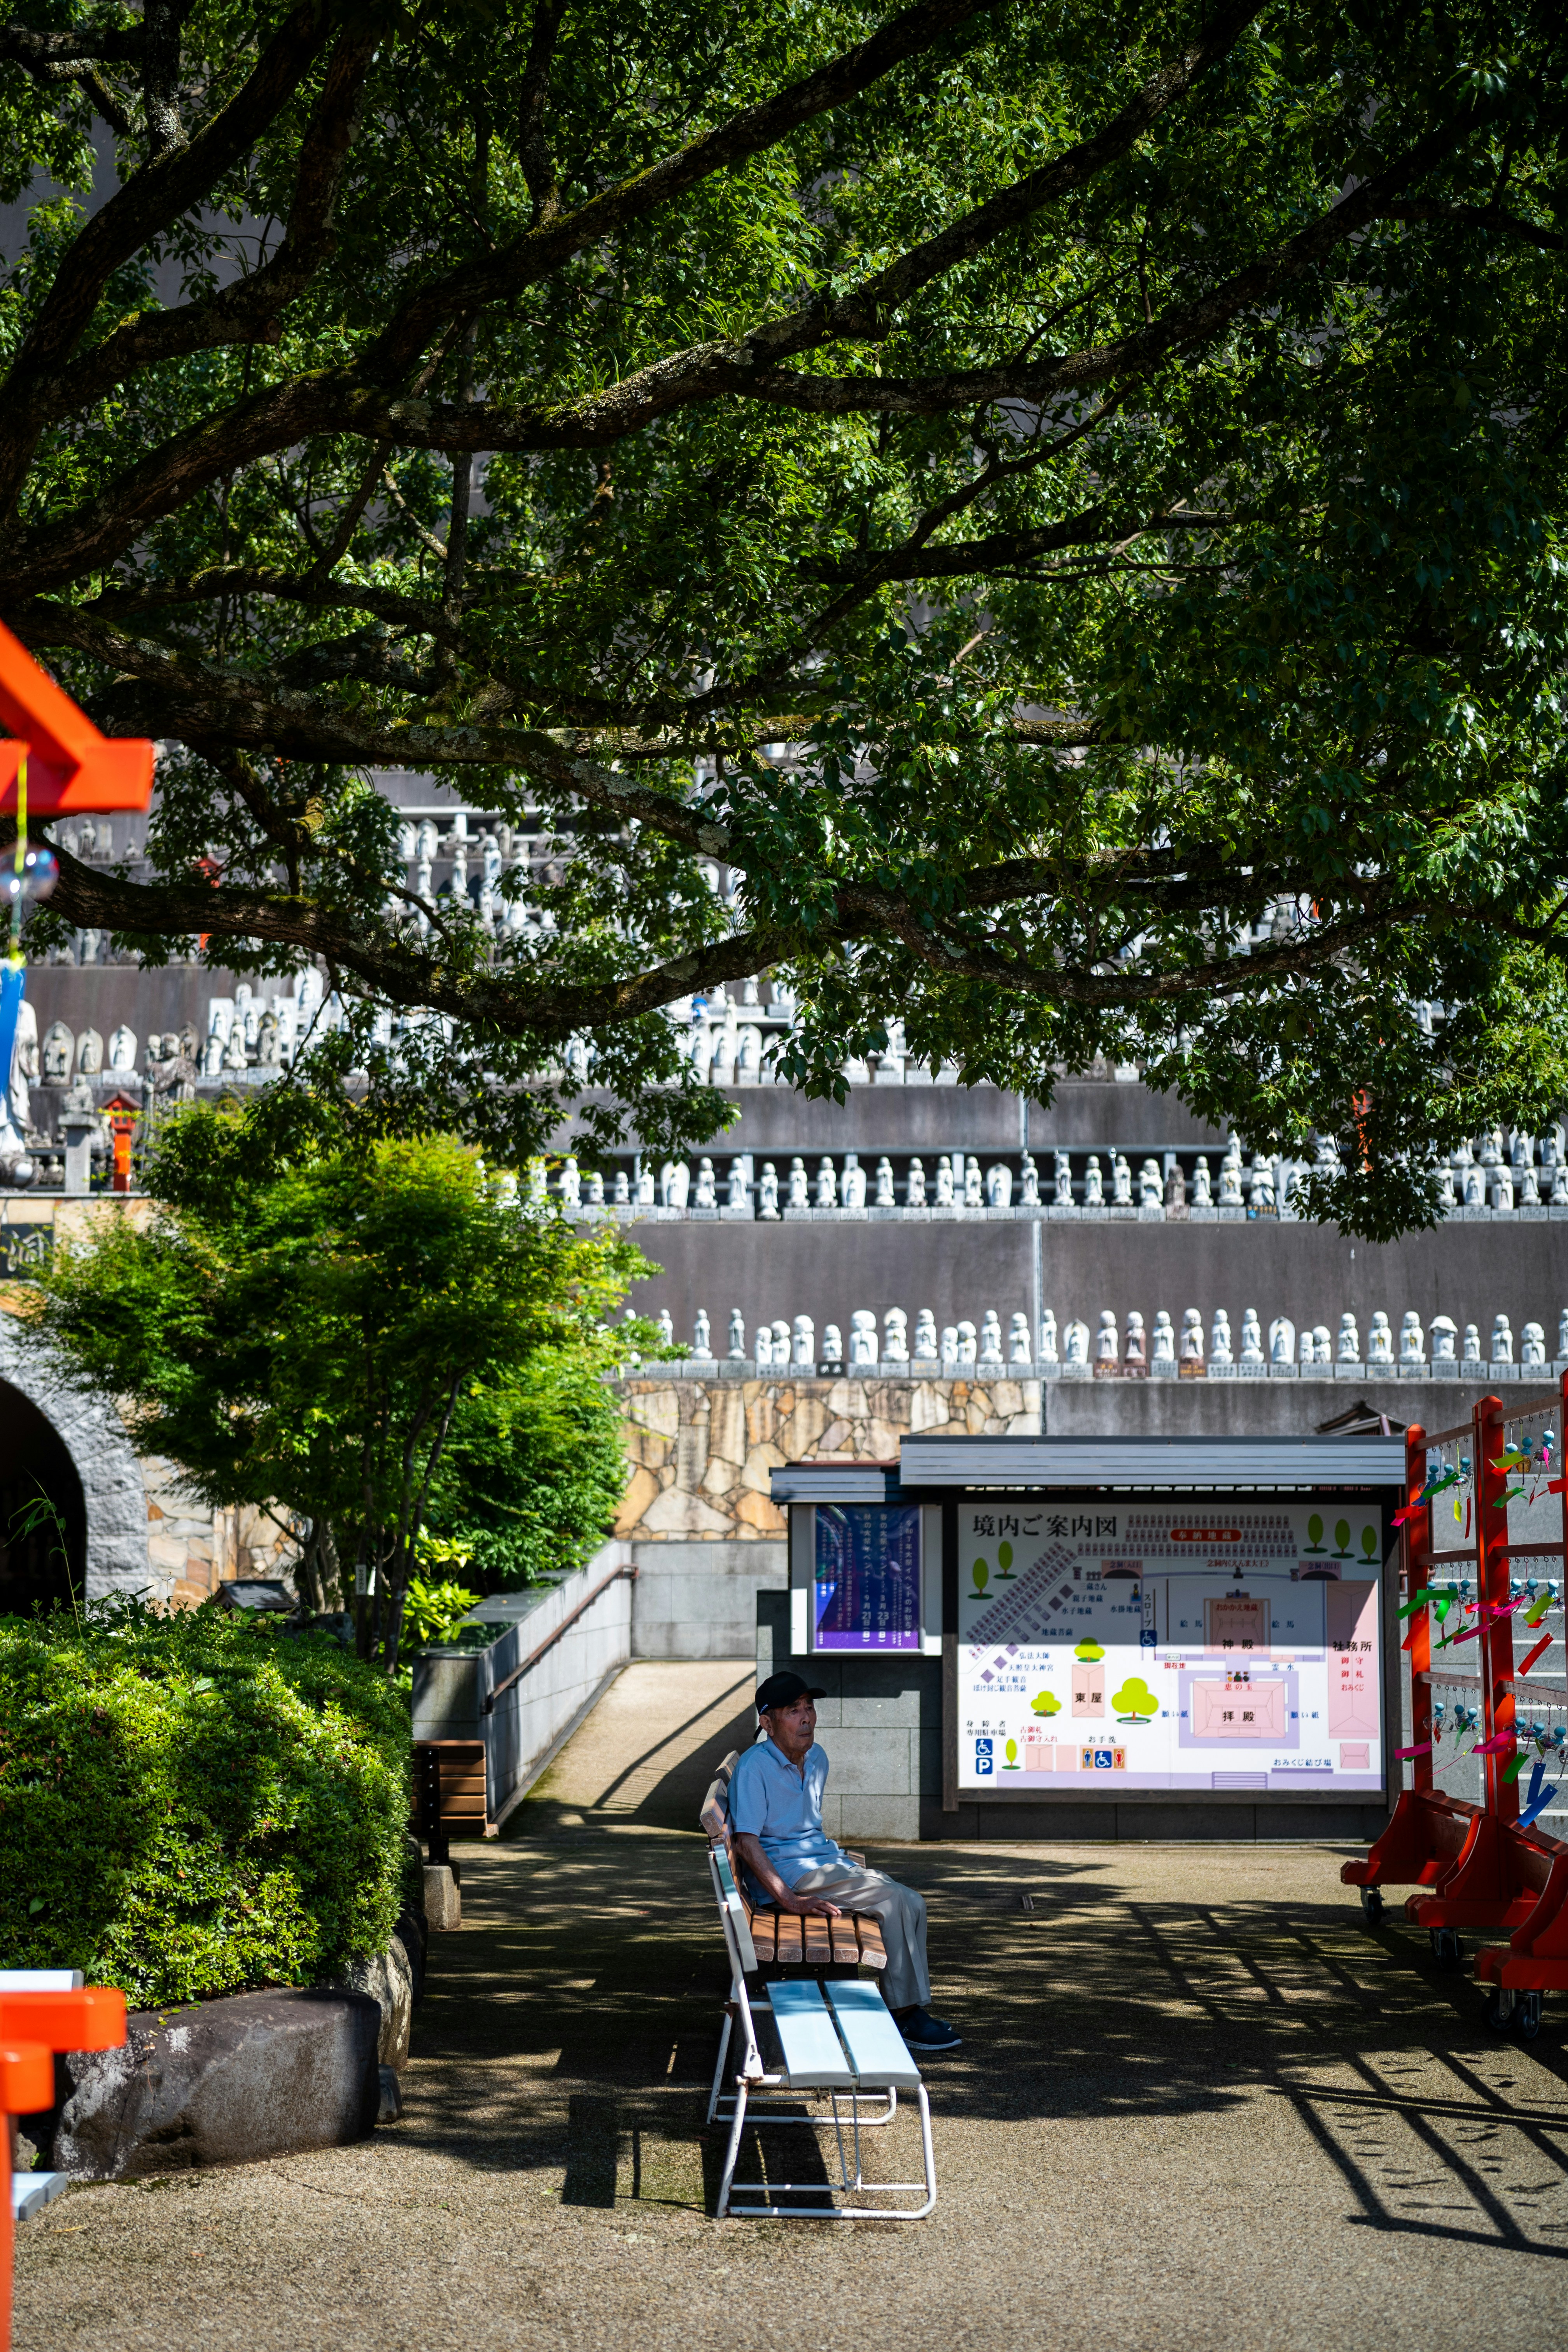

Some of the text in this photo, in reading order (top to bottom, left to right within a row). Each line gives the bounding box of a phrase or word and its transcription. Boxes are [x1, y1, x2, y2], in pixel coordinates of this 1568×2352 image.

[973, 1514, 1117, 1537] 境内ご案内図
[1178, 1531, 1232, 1540] 奉納地蔵
[1062, 1607, 1092, 1615] 水子地蔵
[1216, 1603, 1258, 1612] おかかえ地蔵
[1180, 1619, 1203, 1628] 絵馬
[1272, 1620, 1295, 1628] 絵馬
[1041, 1628, 1073, 1636] 地蔵菩薩
[1222, 1638, 1254, 1650] 神殿
[1333, 1640, 1372, 1652] 社務所
[1341, 1656, 1364, 1665] 御守
[1272, 1663, 1294, 1671] 霊水
[1341, 1670, 1364, 1679] 御札
[1225, 1683, 1253, 1691] 恵の玉
[1074, 1692, 1103, 1704] 東屋
[1162, 1710, 1188, 1718] 願い紙
[1223, 1710, 1255, 1722] 拝殿
[1291, 1711, 1320, 1719] 願い紙
[1020, 1726, 1043, 1734] 古御札
[1020, 1735, 1058, 1743] 古御守入れ
[978, 1759, 990, 1773] P
[1273, 1758, 1332, 1767] おみくじ結び場
